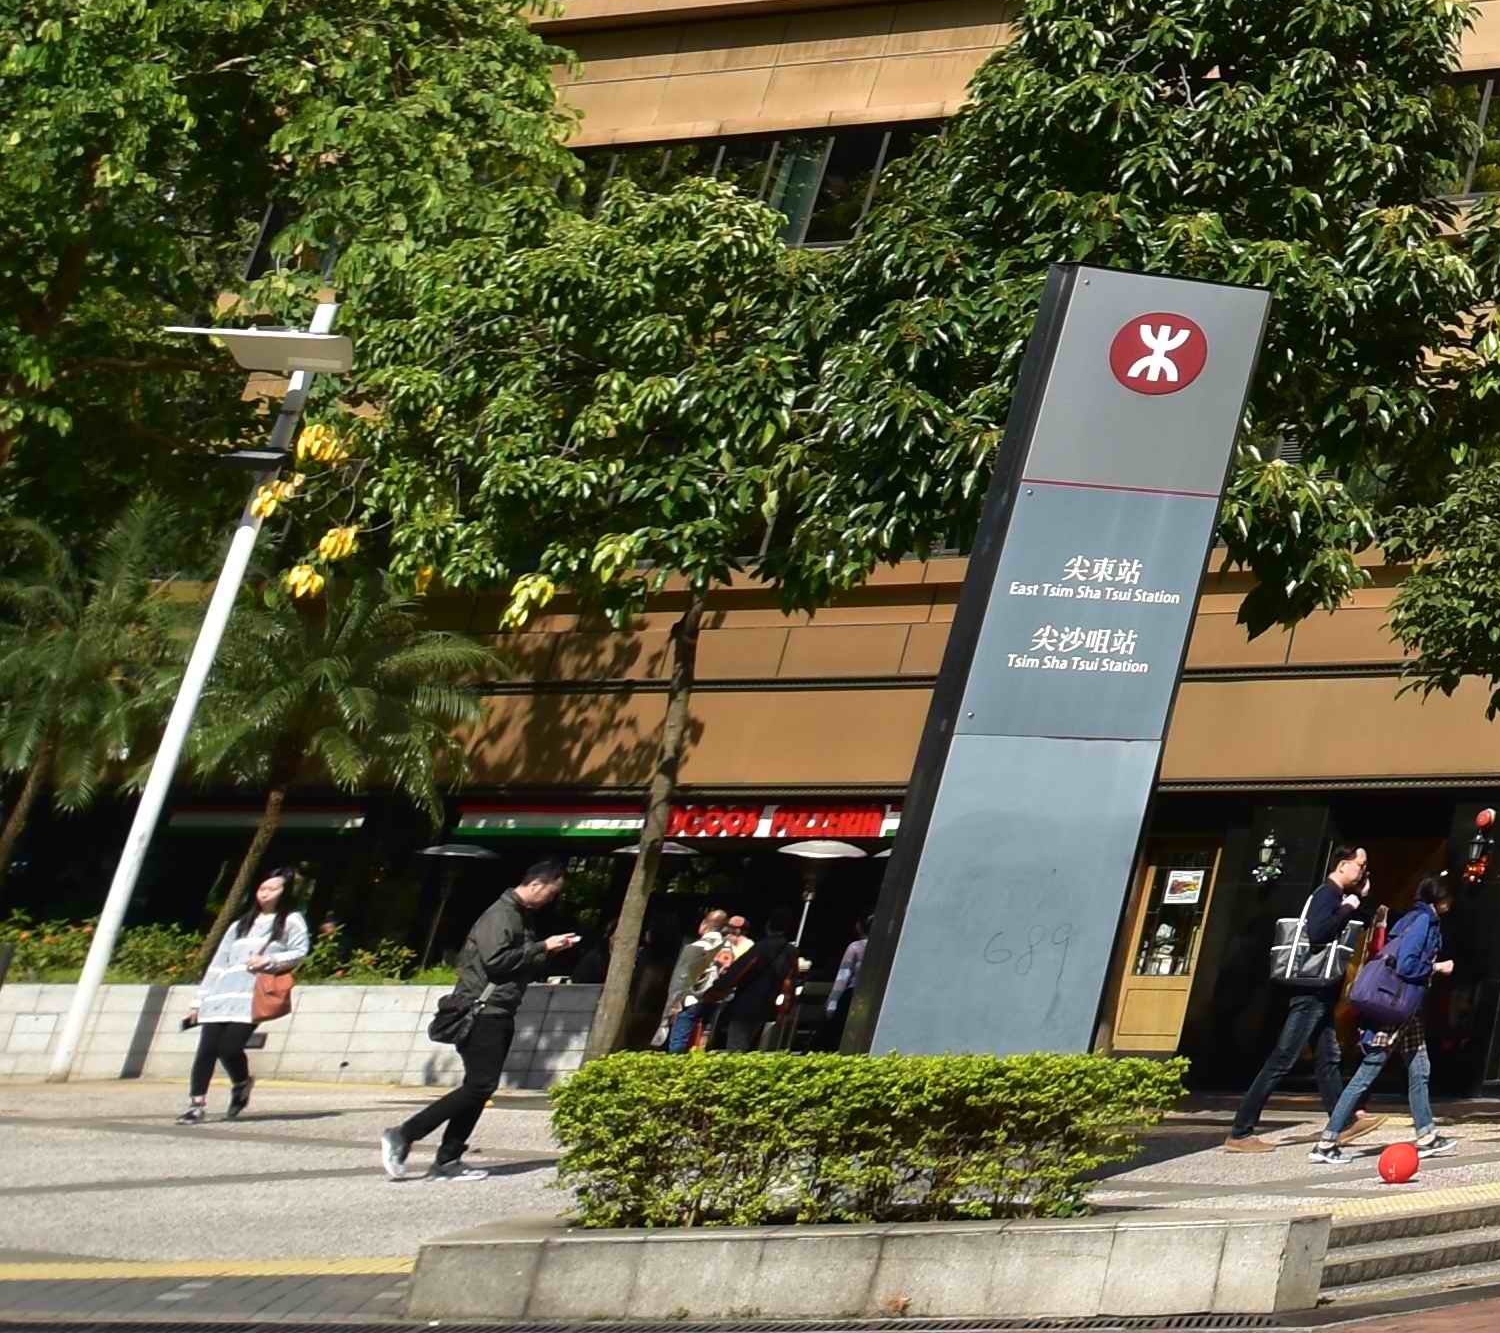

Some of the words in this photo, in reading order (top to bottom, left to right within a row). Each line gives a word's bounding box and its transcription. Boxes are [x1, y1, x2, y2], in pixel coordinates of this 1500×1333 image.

[1062, 555, 1144, 584] 尖東站
[1009, 581, 1039, 597] East
[1042, 583, 1074, 598] Tsim
[1076, 585, 1101, 599] Sha
[1105, 587, 1132, 602] Tsui
[1133, 589, 1181, 605] Station
[1030, 624, 1139, 655] 尖沙咀站
[1007, 653, 1040, 669] Tsim
[1042, 655, 1068, 670] Sha
[1071, 657, 1100, 672] Tsui
[1100, 658, 1149, 673] Station
